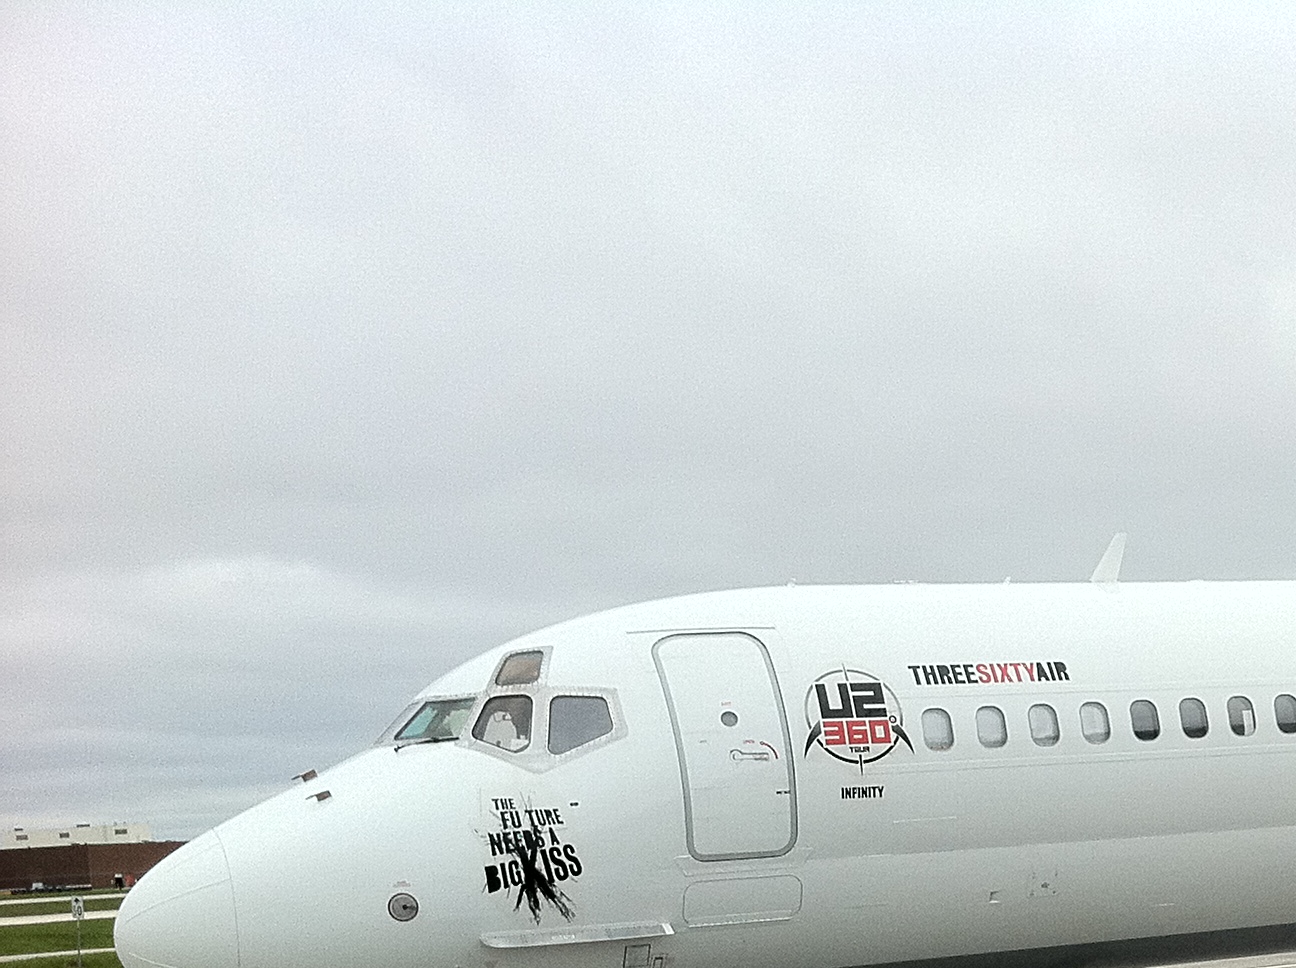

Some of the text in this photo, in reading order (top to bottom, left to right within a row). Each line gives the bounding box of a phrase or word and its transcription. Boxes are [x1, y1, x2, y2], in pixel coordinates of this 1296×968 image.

[814, 682, 888, 719] U2
[491, 798, 516, 811] THE
[841, 786, 884, 799] INFINITY
[488, 827, 560, 857] NEEDS A
[484, 844, 583, 912] BIG KISS
